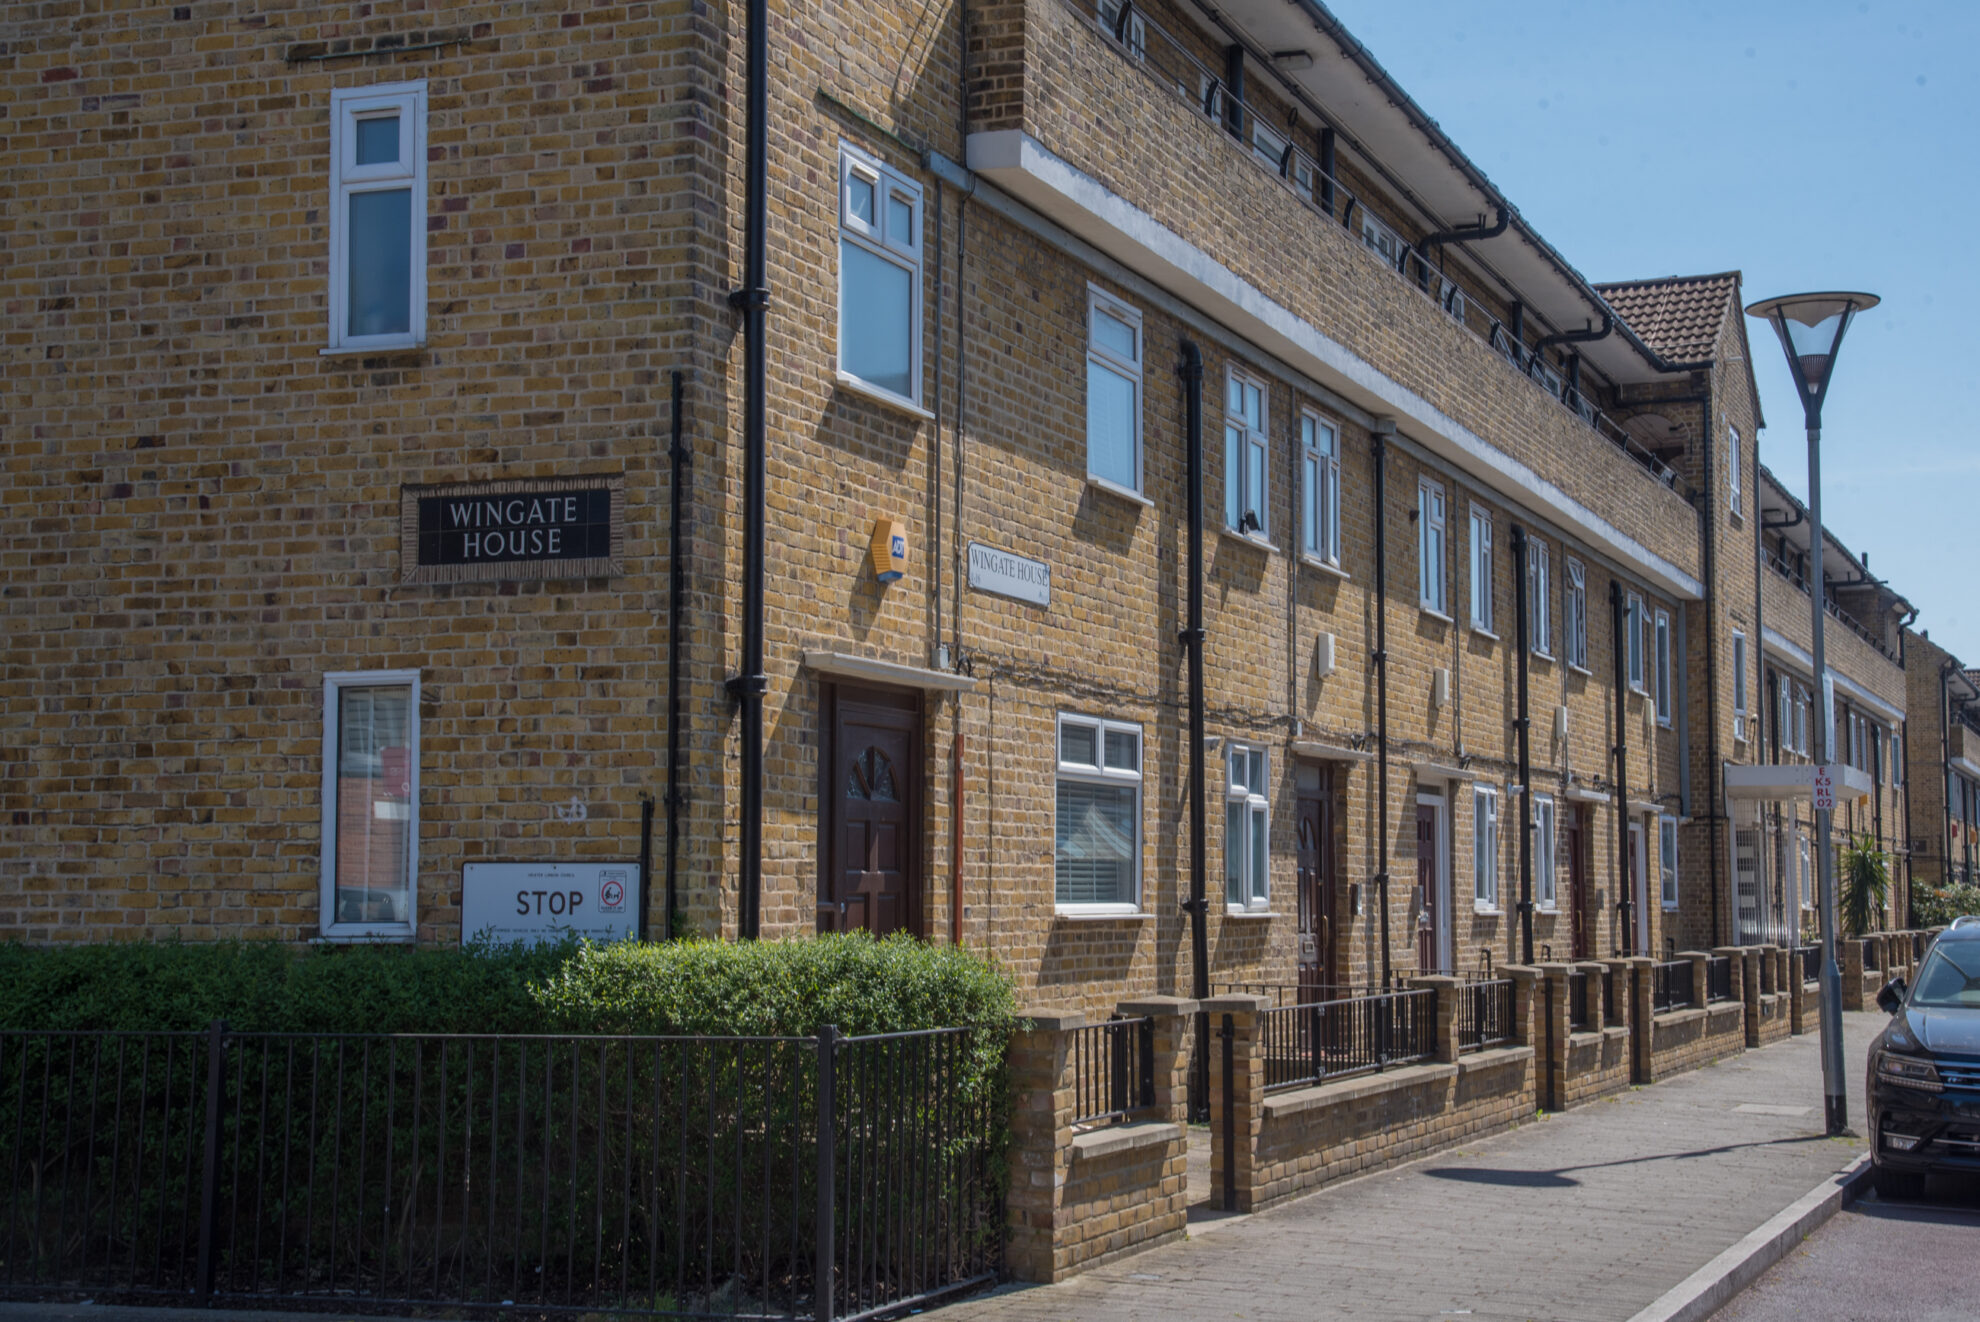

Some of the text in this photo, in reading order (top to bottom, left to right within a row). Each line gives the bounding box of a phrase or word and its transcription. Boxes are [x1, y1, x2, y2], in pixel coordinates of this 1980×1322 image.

[450, 497, 578, 528] WINGATE
[463, 529, 562, 558] HOUSE
[971, 548, 1048, 587] WINGATE HOUSE
[516, 890, 583, 915] STOP
